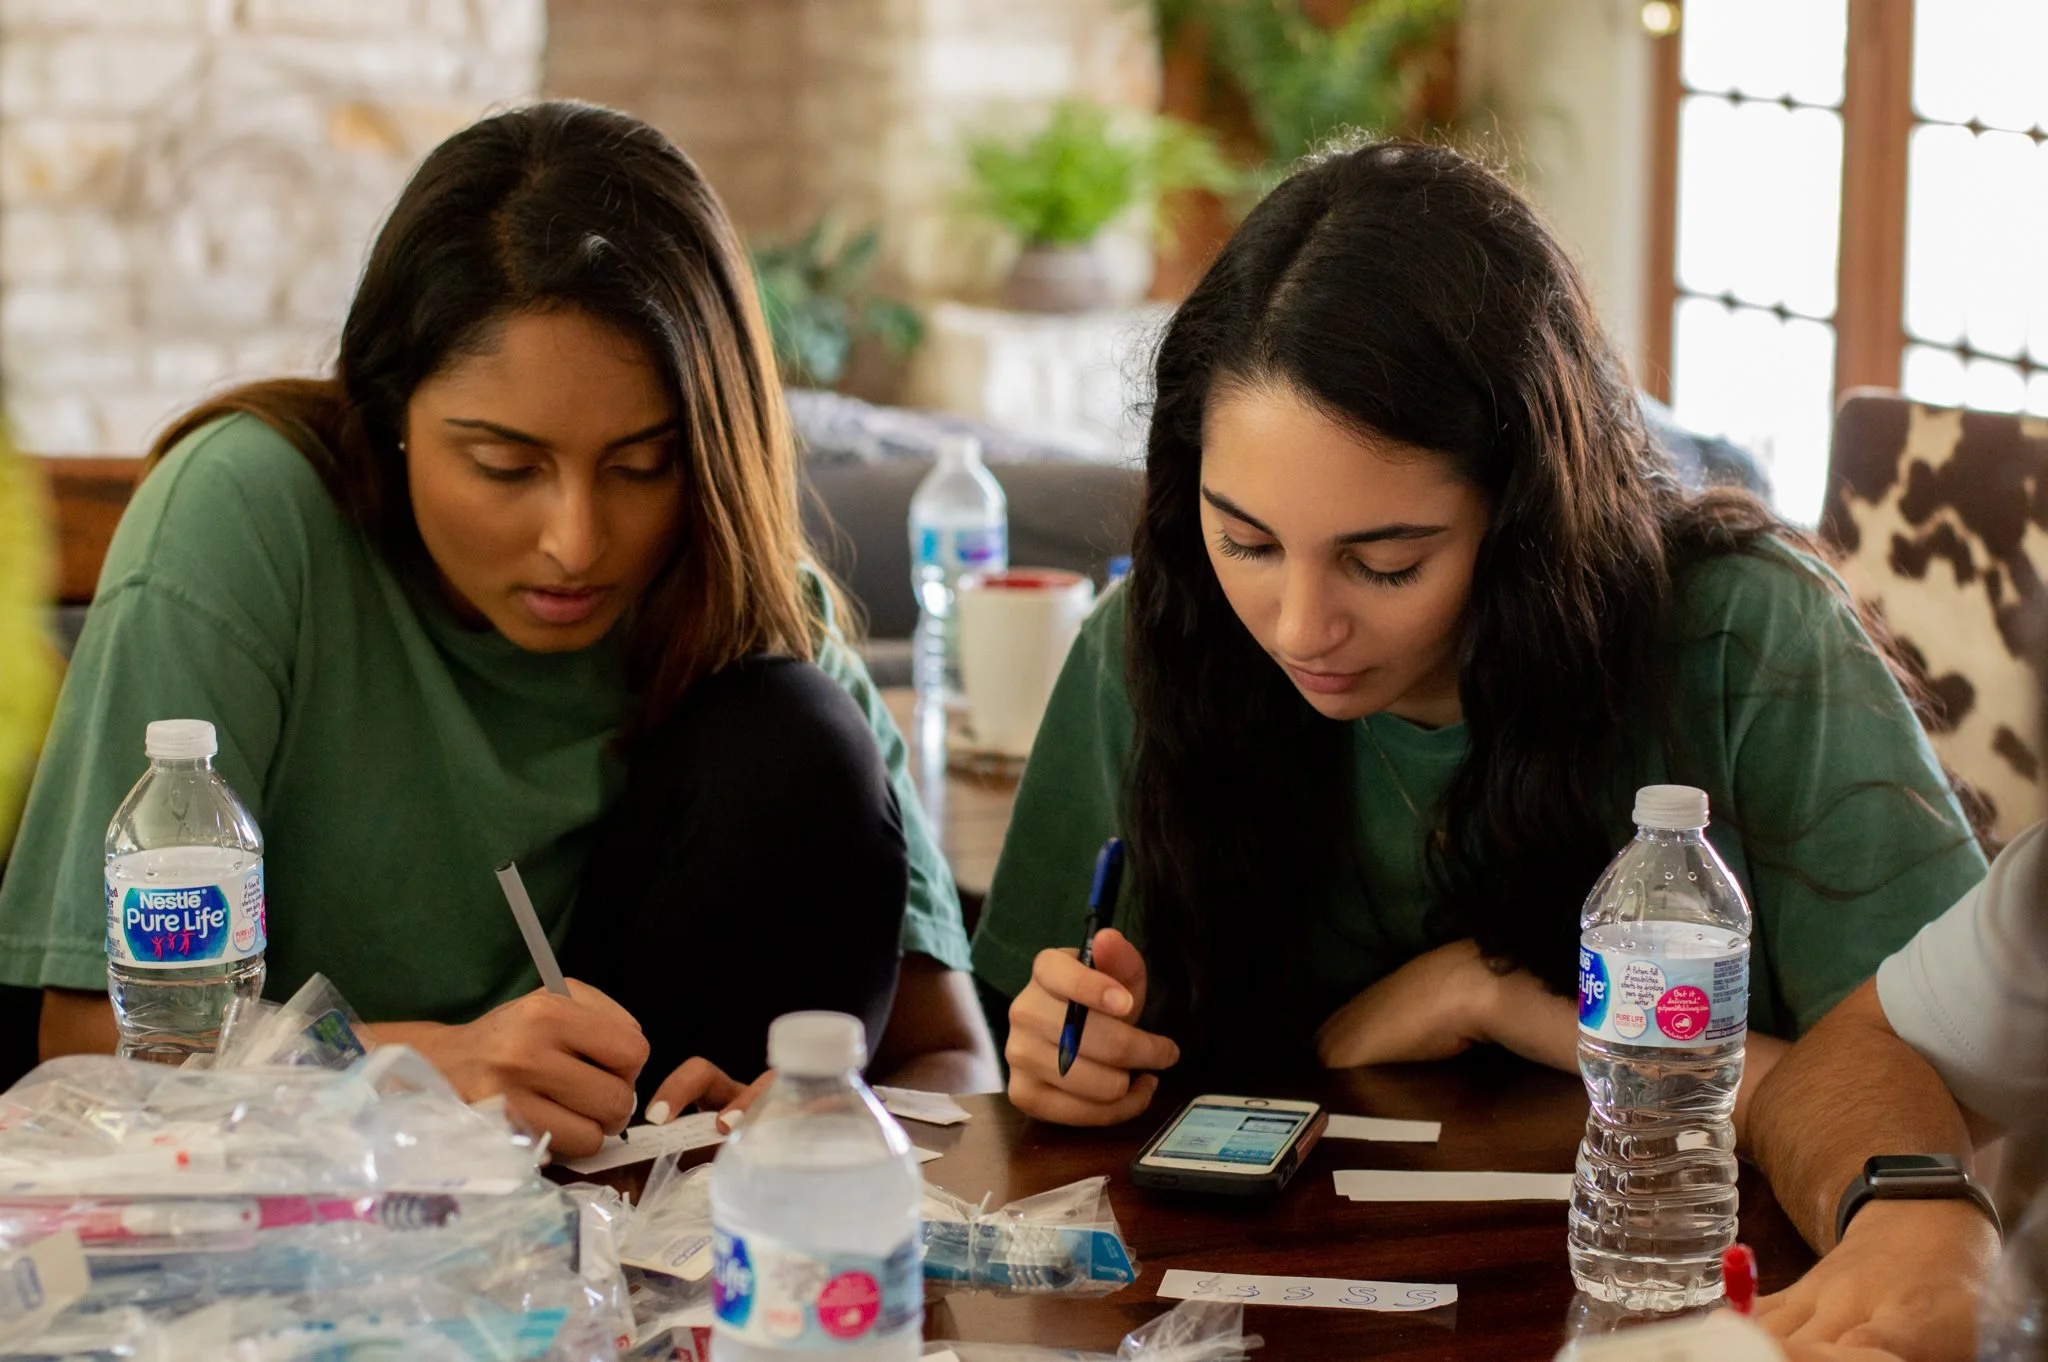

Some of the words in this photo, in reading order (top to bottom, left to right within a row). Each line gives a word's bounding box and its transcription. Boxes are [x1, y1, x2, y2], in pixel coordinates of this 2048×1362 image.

[127, 908, 180, 932] Pure
[185, 907, 225, 939] Life
[1581, 971, 1605, 1005] Life
[1616, 1013, 1630, 1021] PURE
[1631, 1015, 1644, 1023] LIFE
